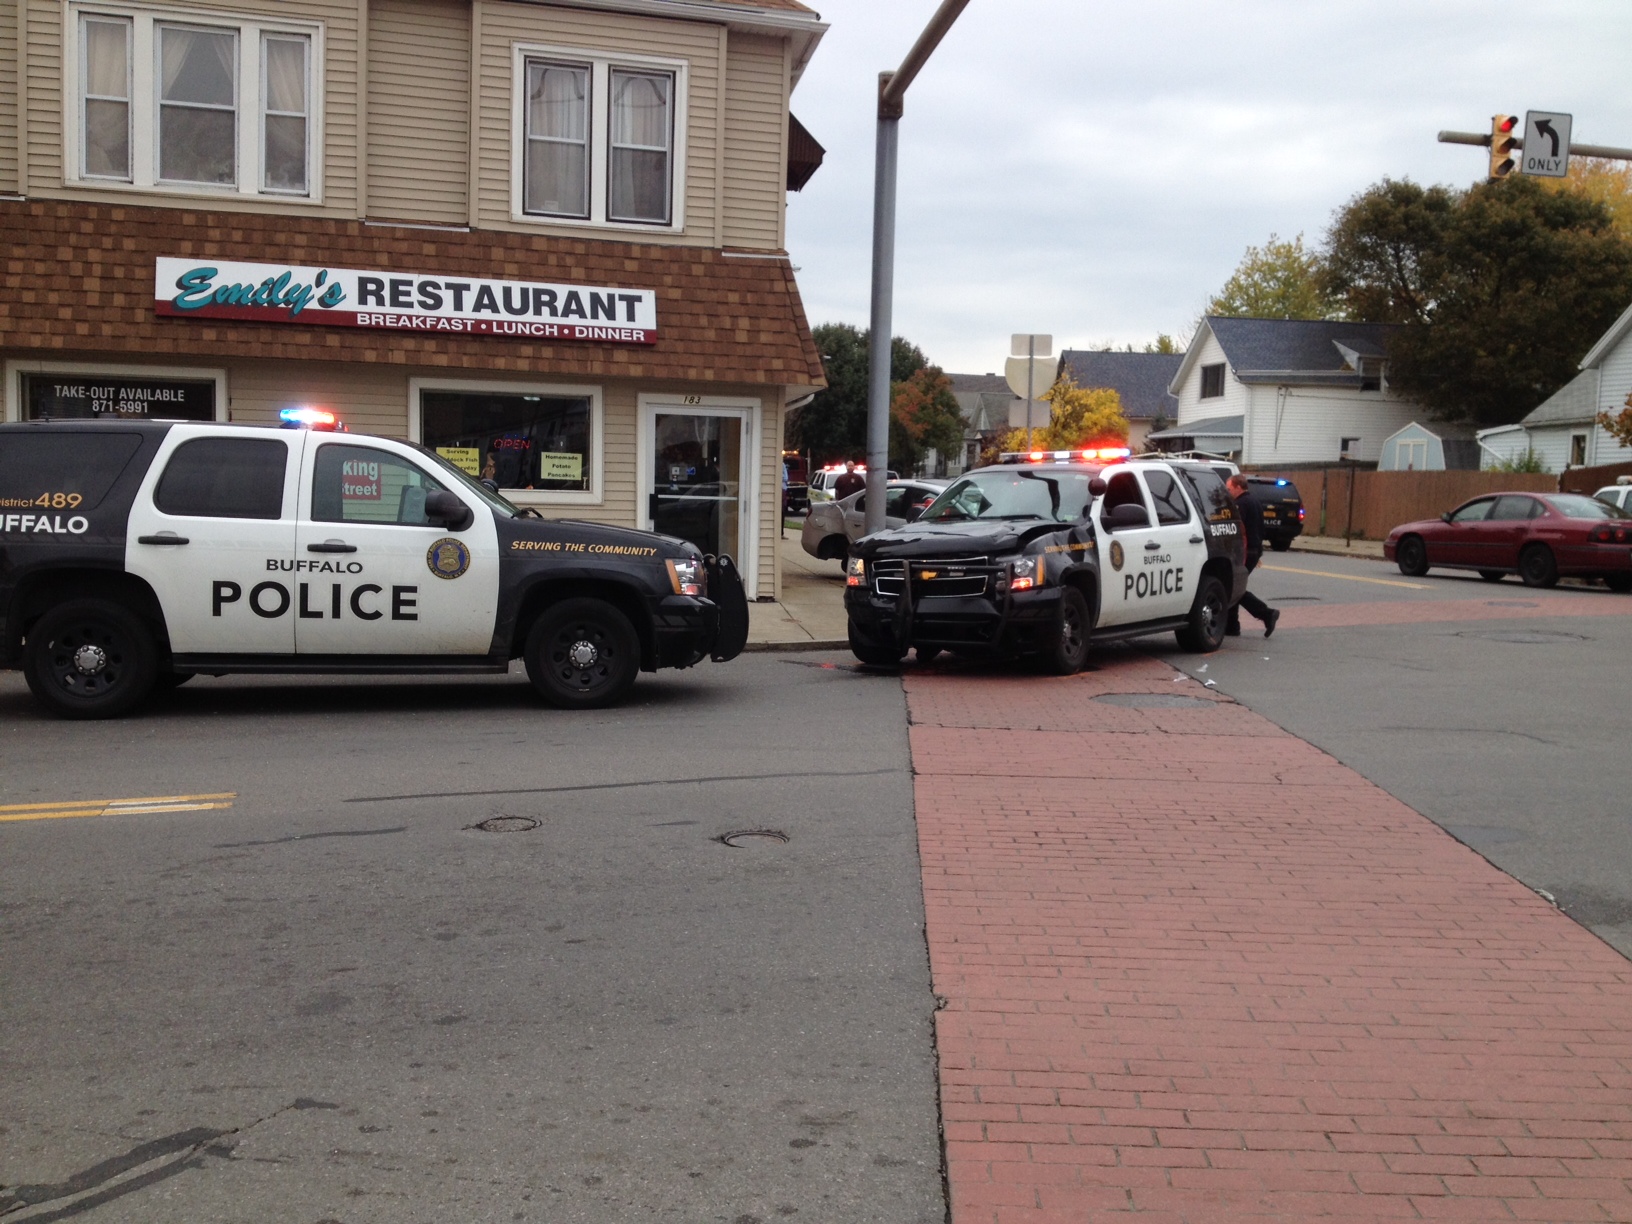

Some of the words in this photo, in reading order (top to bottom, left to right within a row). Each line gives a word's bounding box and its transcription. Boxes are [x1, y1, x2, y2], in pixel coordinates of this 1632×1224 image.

[1528, 157, 1561, 172] ONLY
[172, 267, 347, 318] Emily's
[357, 276, 643, 323] RESTAURANT
[357, 313, 475, 331] BREAKFAST
[492, 321, 558, 336] LUNCH
[574, 326, 645, 341] DINNER
[54, 385, 115, 399] TAKE-OUT
[119, 388, 185, 401] AVAILABLE
[684, 396, 701, 404] 183
[92, 400, 148, 413] 871-5991
[494, 439, 531, 450] OPEN
[342, 482, 377, 495] treet
[0, 498, 34, 508] istrict
[35, 492, 83, 509] 489
[1210, 523, 1237, 536] BUFFALO
[511, 540, 561, 551] SERVING
[565, 542, 586, 552] THE
[588, 544, 657, 556] COMMUNITY
[266, 558, 363, 574] BUFFALO
[1144, 554, 1171, 565] BUFFALO
[1124, 568, 1183, 600] POLICE
[212, 580, 417, 622] POLICE
